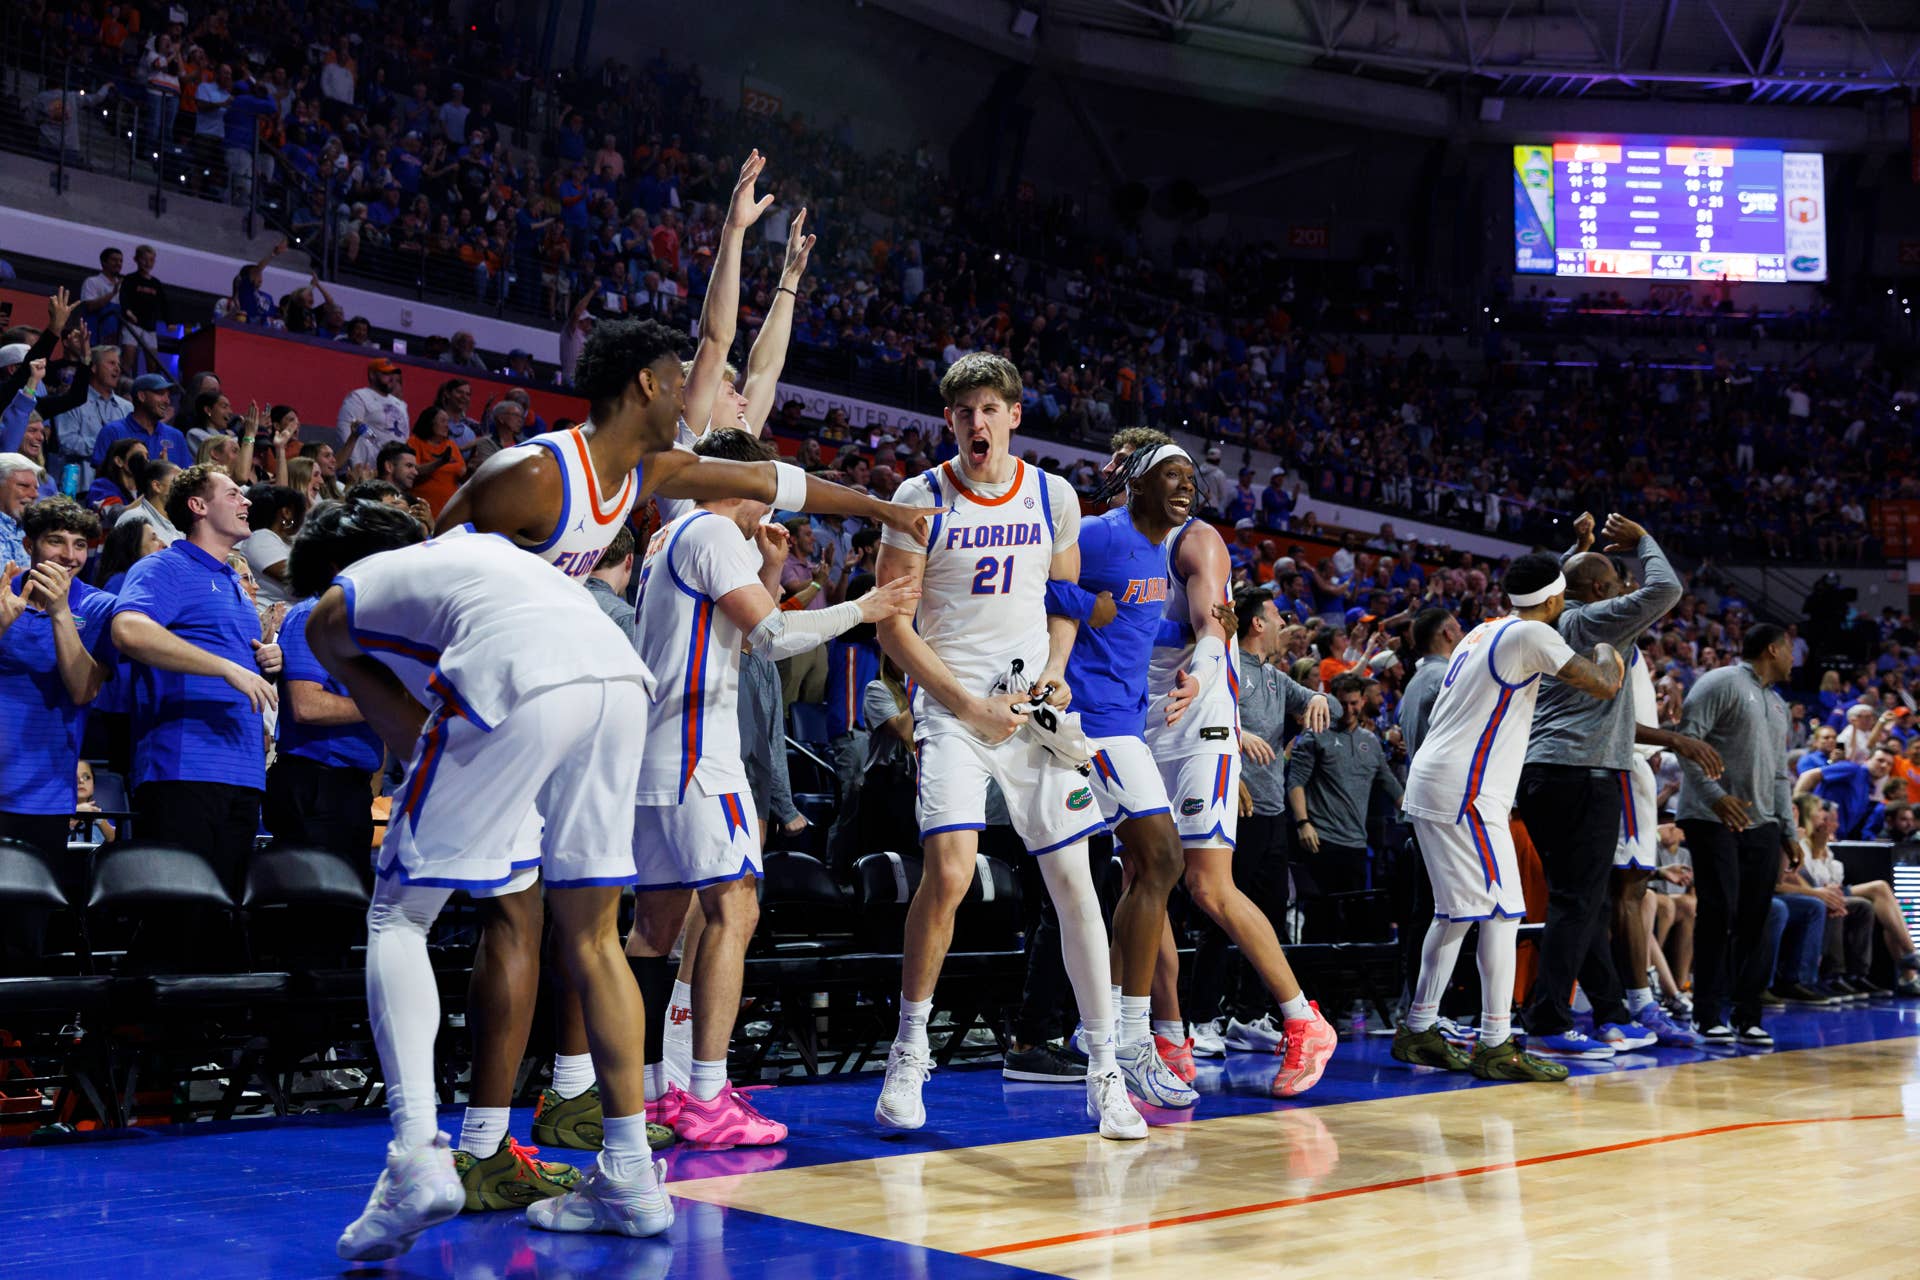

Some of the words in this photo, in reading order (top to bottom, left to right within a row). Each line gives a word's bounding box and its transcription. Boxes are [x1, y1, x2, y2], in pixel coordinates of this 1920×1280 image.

[1294, 229, 1325, 246] 201
[1580, 220, 1597, 234] 14
[945, 523, 1042, 550] FLORIDA
[971, 555, 1015, 595] 21
[1444, 650, 1469, 688] 0
